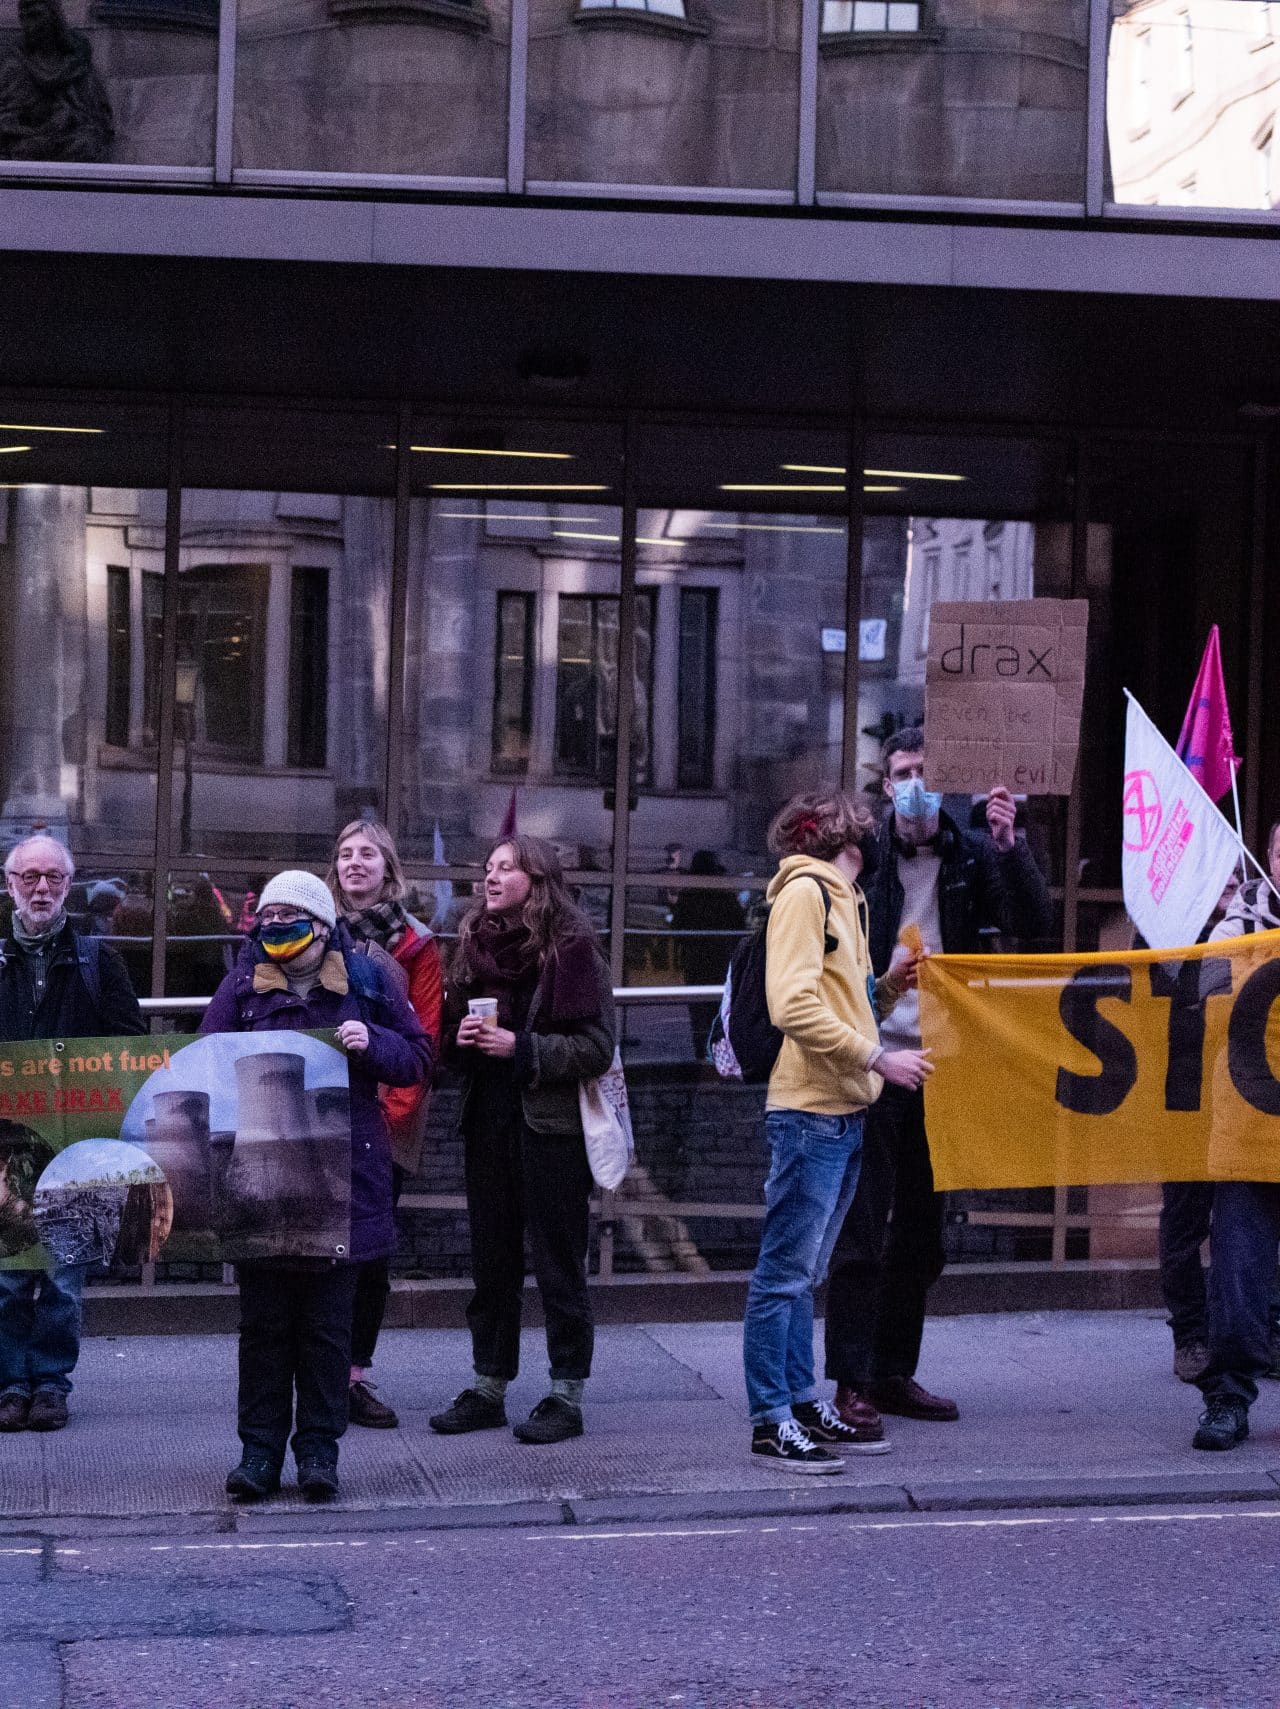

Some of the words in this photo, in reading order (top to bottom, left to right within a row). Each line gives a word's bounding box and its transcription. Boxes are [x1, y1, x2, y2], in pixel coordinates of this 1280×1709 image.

[940, 622, 1053, 679] drax
[939, 703, 988, 721] even
[944, 735, 1002, 751] name
[1013, 762, 1059, 784] evil
[22, 1057, 63, 1076] are
[70, 1051, 113, 1073] not
[120, 1049, 170, 1072] fuel
[54, 1087, 123, 1110] DRAX
